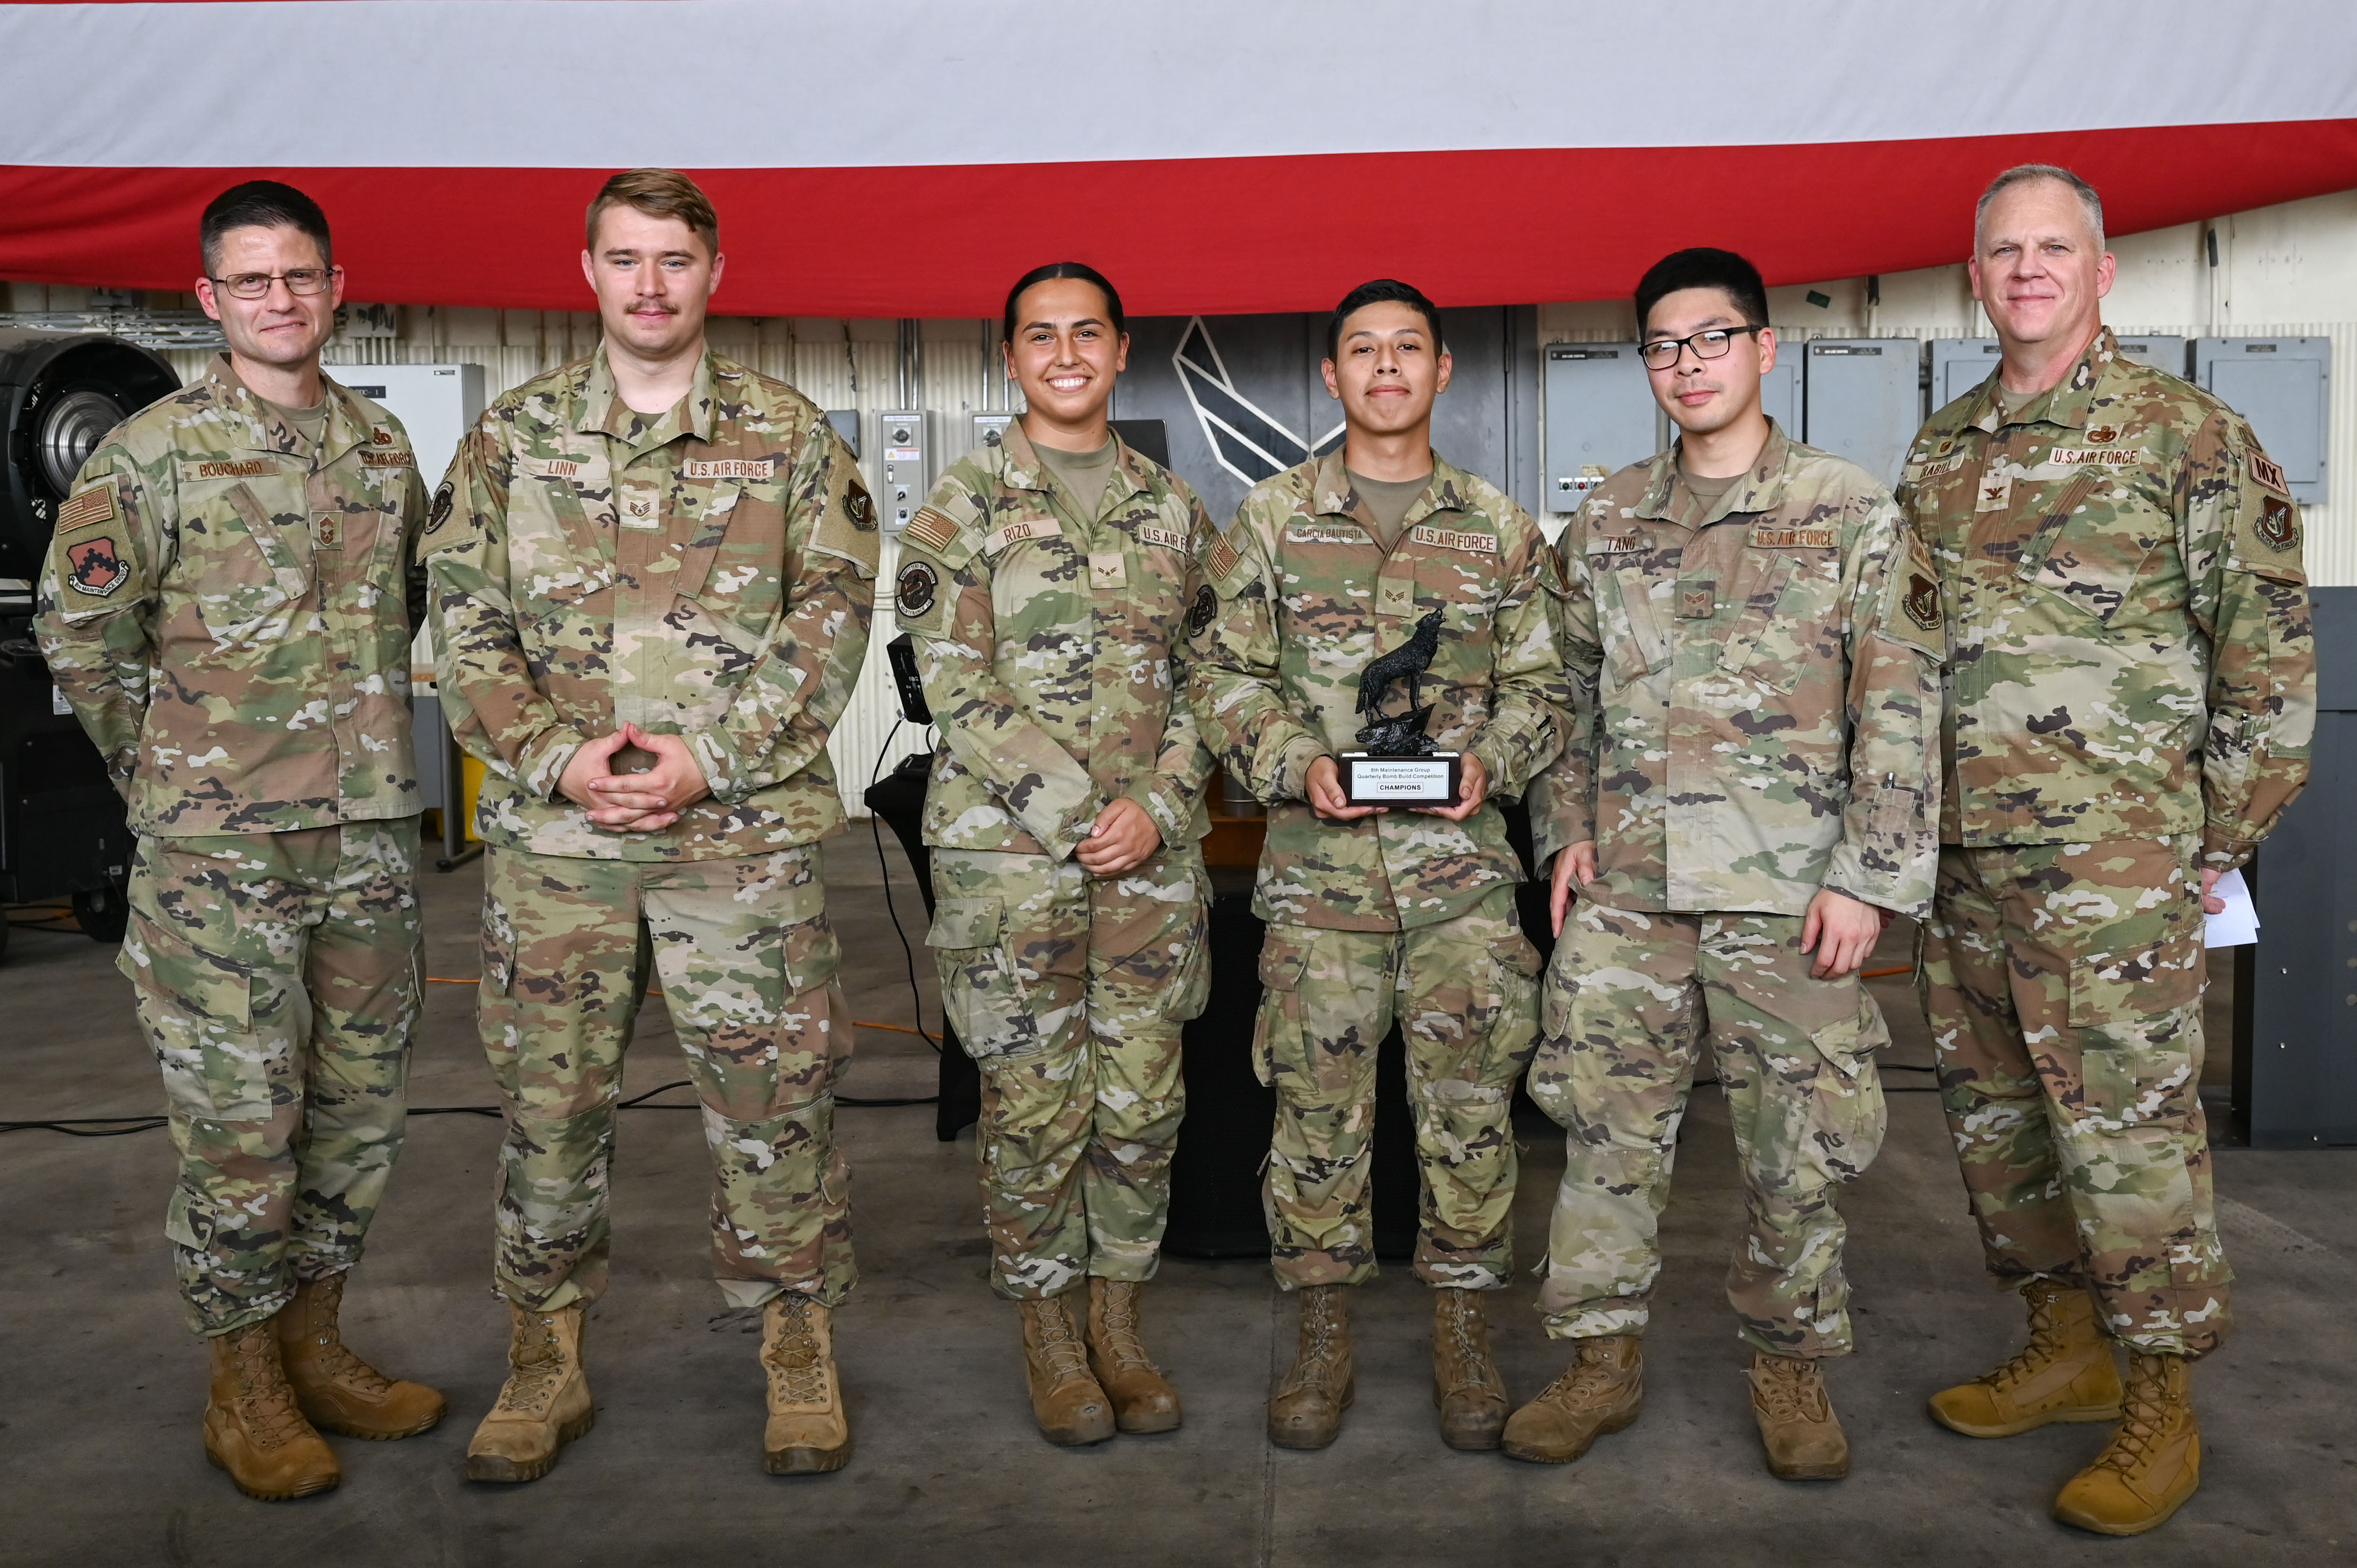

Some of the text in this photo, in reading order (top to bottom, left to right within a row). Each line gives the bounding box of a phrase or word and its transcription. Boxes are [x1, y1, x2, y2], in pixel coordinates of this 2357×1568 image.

[376, 453, 390, 464] AIR
[2054, 450, 2137, 464] U.S. AIR FORCE
[199, 461, 262, 478] BOUCHARD
[548, 461, 577, 476] LINN
[690, 462, 768, 477] U.S. AIR FORCE
[2255, 457, 2281, 489] MX
[1003, 524, 1031, 543] RIZO
[1144, 527, 1163, 542] U.S.
[1164, 532, 1178, 548] AIR
[1297, 529, 1362, 540] GARCIA BAUTISTA
[1416, 528, 1493, 550] U.S. AIR FORCE
[1757, 530, 1833, 545] U.S. AIR FORCE
[1608, 537, 1636, 551] TANG
